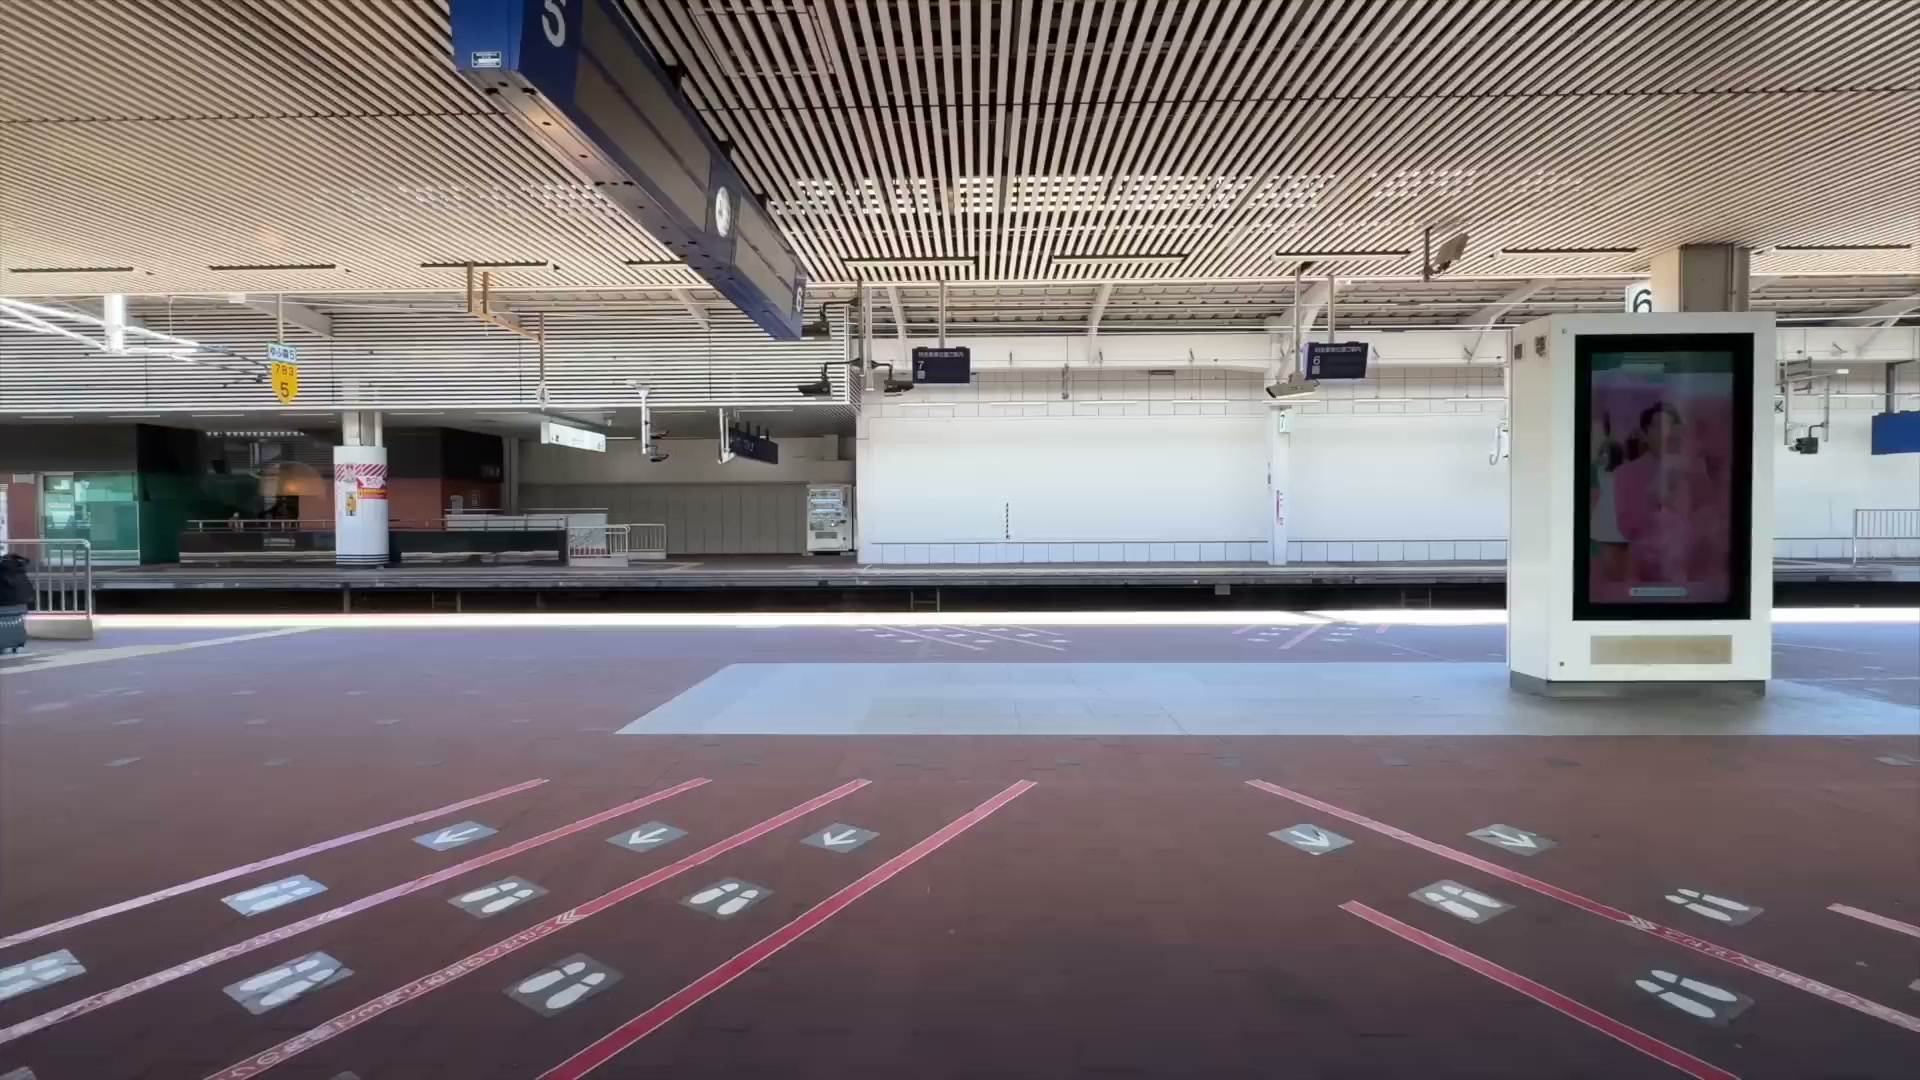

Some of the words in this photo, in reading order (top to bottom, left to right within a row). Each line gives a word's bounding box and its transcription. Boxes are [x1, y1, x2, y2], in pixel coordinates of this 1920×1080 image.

[796, 286, 803, 312] 6
[1633, 289, 1652, 313] 6
[917, 361, 925, 370] 7
[1313, 355, 1321, 365] 6
[280, 382, 290, 398] 5
[1280, 414, 1285, 428] 7
